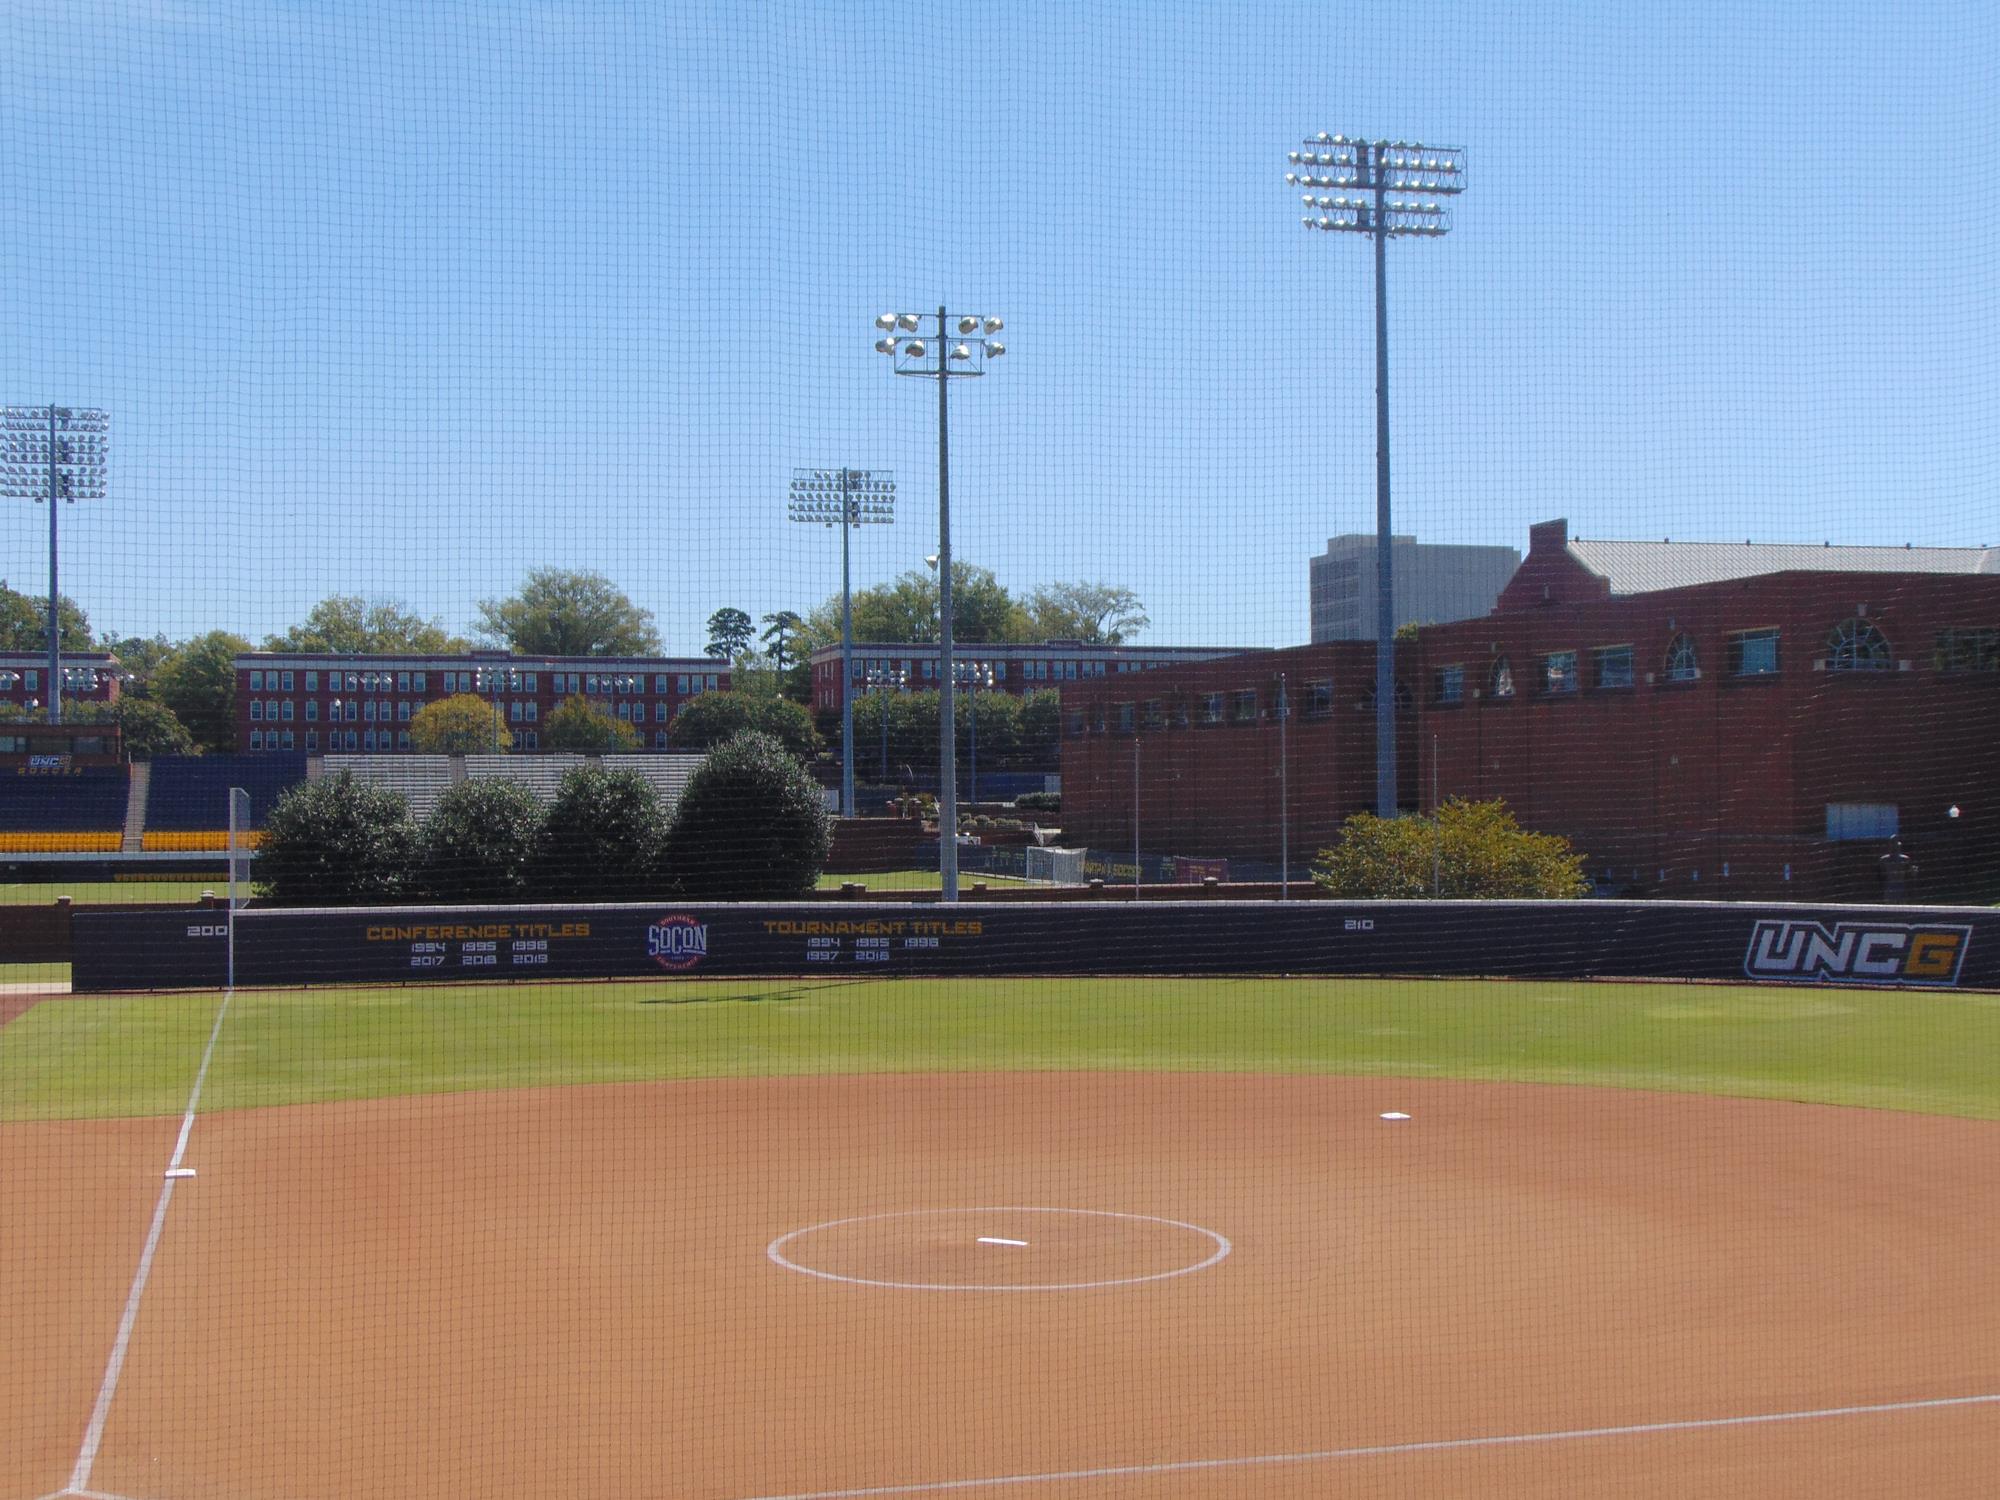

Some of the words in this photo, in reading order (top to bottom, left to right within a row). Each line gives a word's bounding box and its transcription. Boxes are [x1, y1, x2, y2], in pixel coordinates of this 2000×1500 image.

[31, 755, 71, 768] UNCG
[187, 925, 229, 937] 200
[763, 920, 908, 935] TOURNAMENT
[910, 920, 983, 934] TITLES
[1344, 919, 1374, 930] 210
[366, 924, 512, 941] CONFERENCE
[515, 922, 590, 938] TITLES
[411, 942, 446, 953] 1994
[462, 941, 497, 952] 1995
[512, 940, 548, 951] 1996
[807, 937, 841, 948] 1994
[855, 937, 890, 948] 1995
[904, 937, 939, 948] 1996
[806, 951, 840, 961] 1997
[1753, 928, 1960, 976] UNCG
[410, 956, 446, 966] 2017
[462, 955, 497, 965] 2018
[512, 953, 549, 964] 2019
